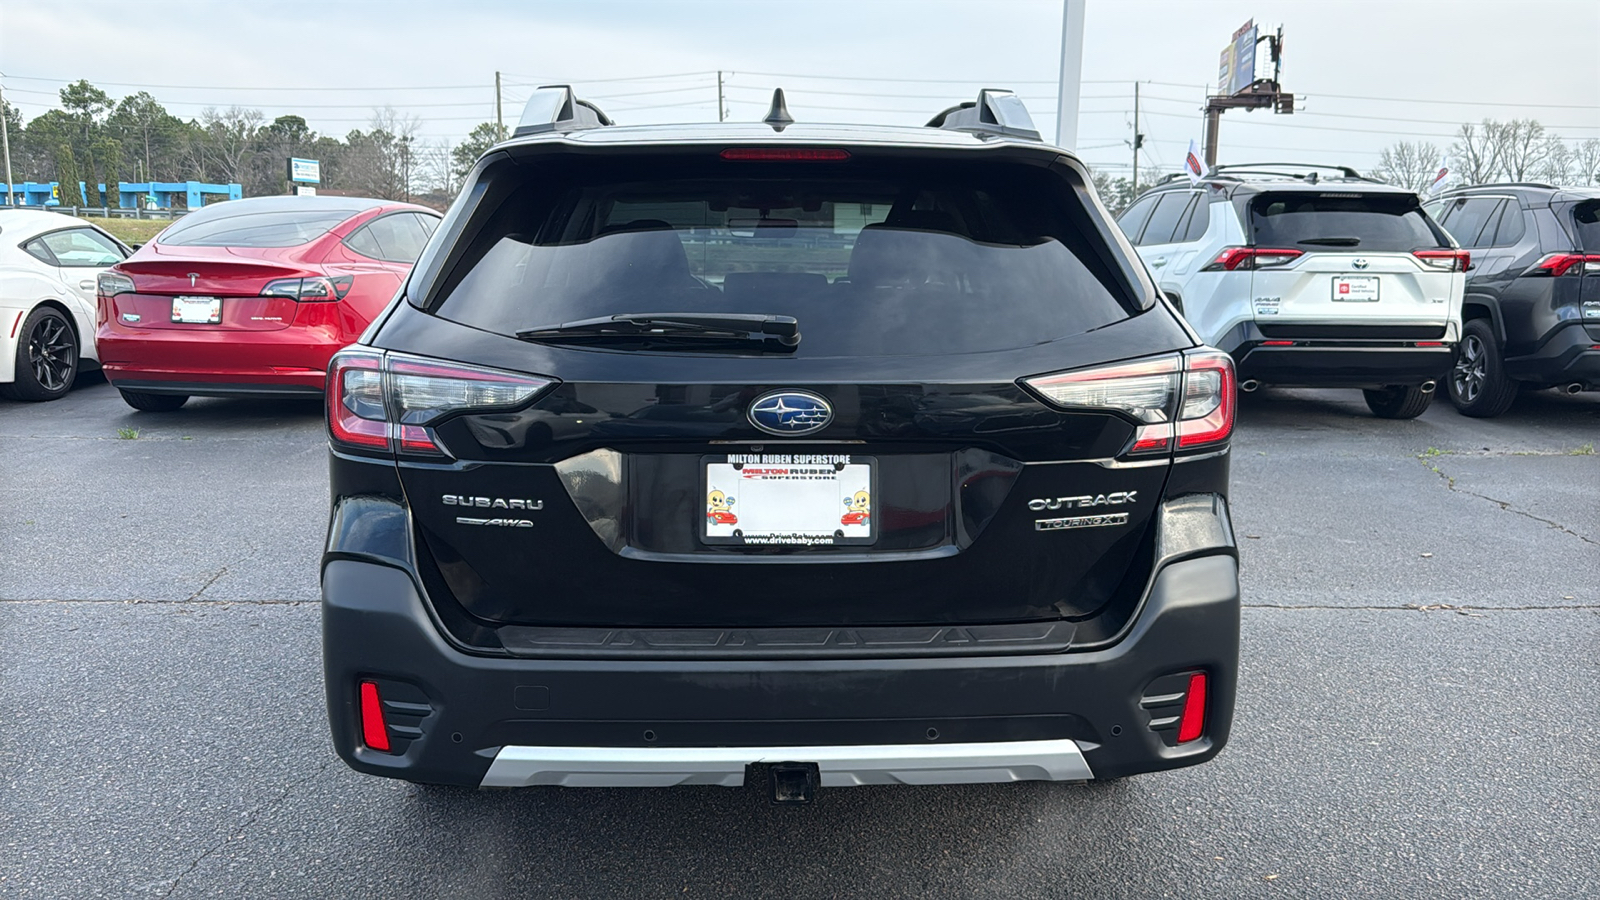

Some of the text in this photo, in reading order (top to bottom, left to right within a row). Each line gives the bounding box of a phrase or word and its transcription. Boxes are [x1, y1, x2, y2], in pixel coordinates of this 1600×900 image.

[727, 454, 851, 464] MILTON RUBEN SUPERSTORE
[442, 494, 544, 510] SUBARU
[1028, 490, 1138, 511] OUTBACK
[1045, 517, 1102, 528] TOURING
[744, 537, 834, 546] www.drivebaby.com
